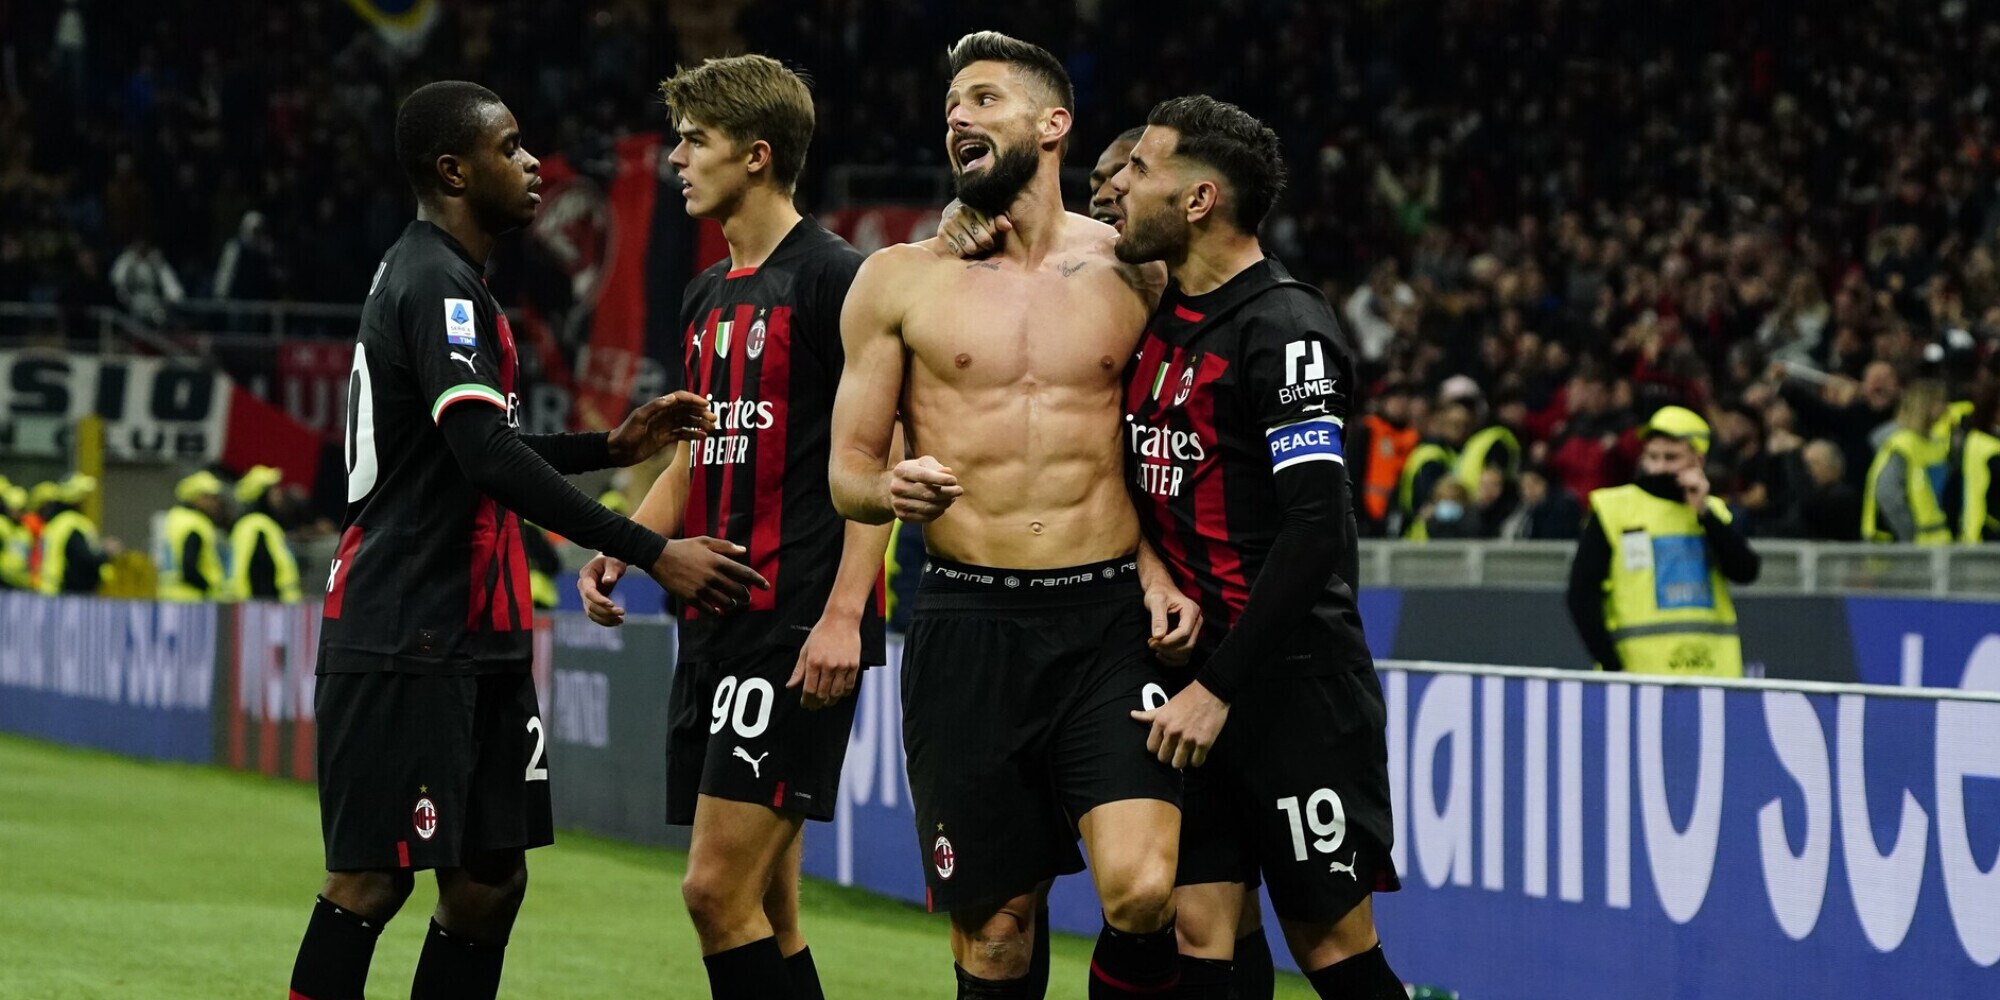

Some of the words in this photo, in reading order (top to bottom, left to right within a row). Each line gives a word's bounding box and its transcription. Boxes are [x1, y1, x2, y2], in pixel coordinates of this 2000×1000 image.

[1271, 430, 1331, 457] PEACE
[935, 566, 994, 584] ranna
[1030, 572, 1093, 587] ranna
[709, 675, 775, 738] 90
[525, 716, 548, 781] 2
[1277, 787, 1346, 861] 19
